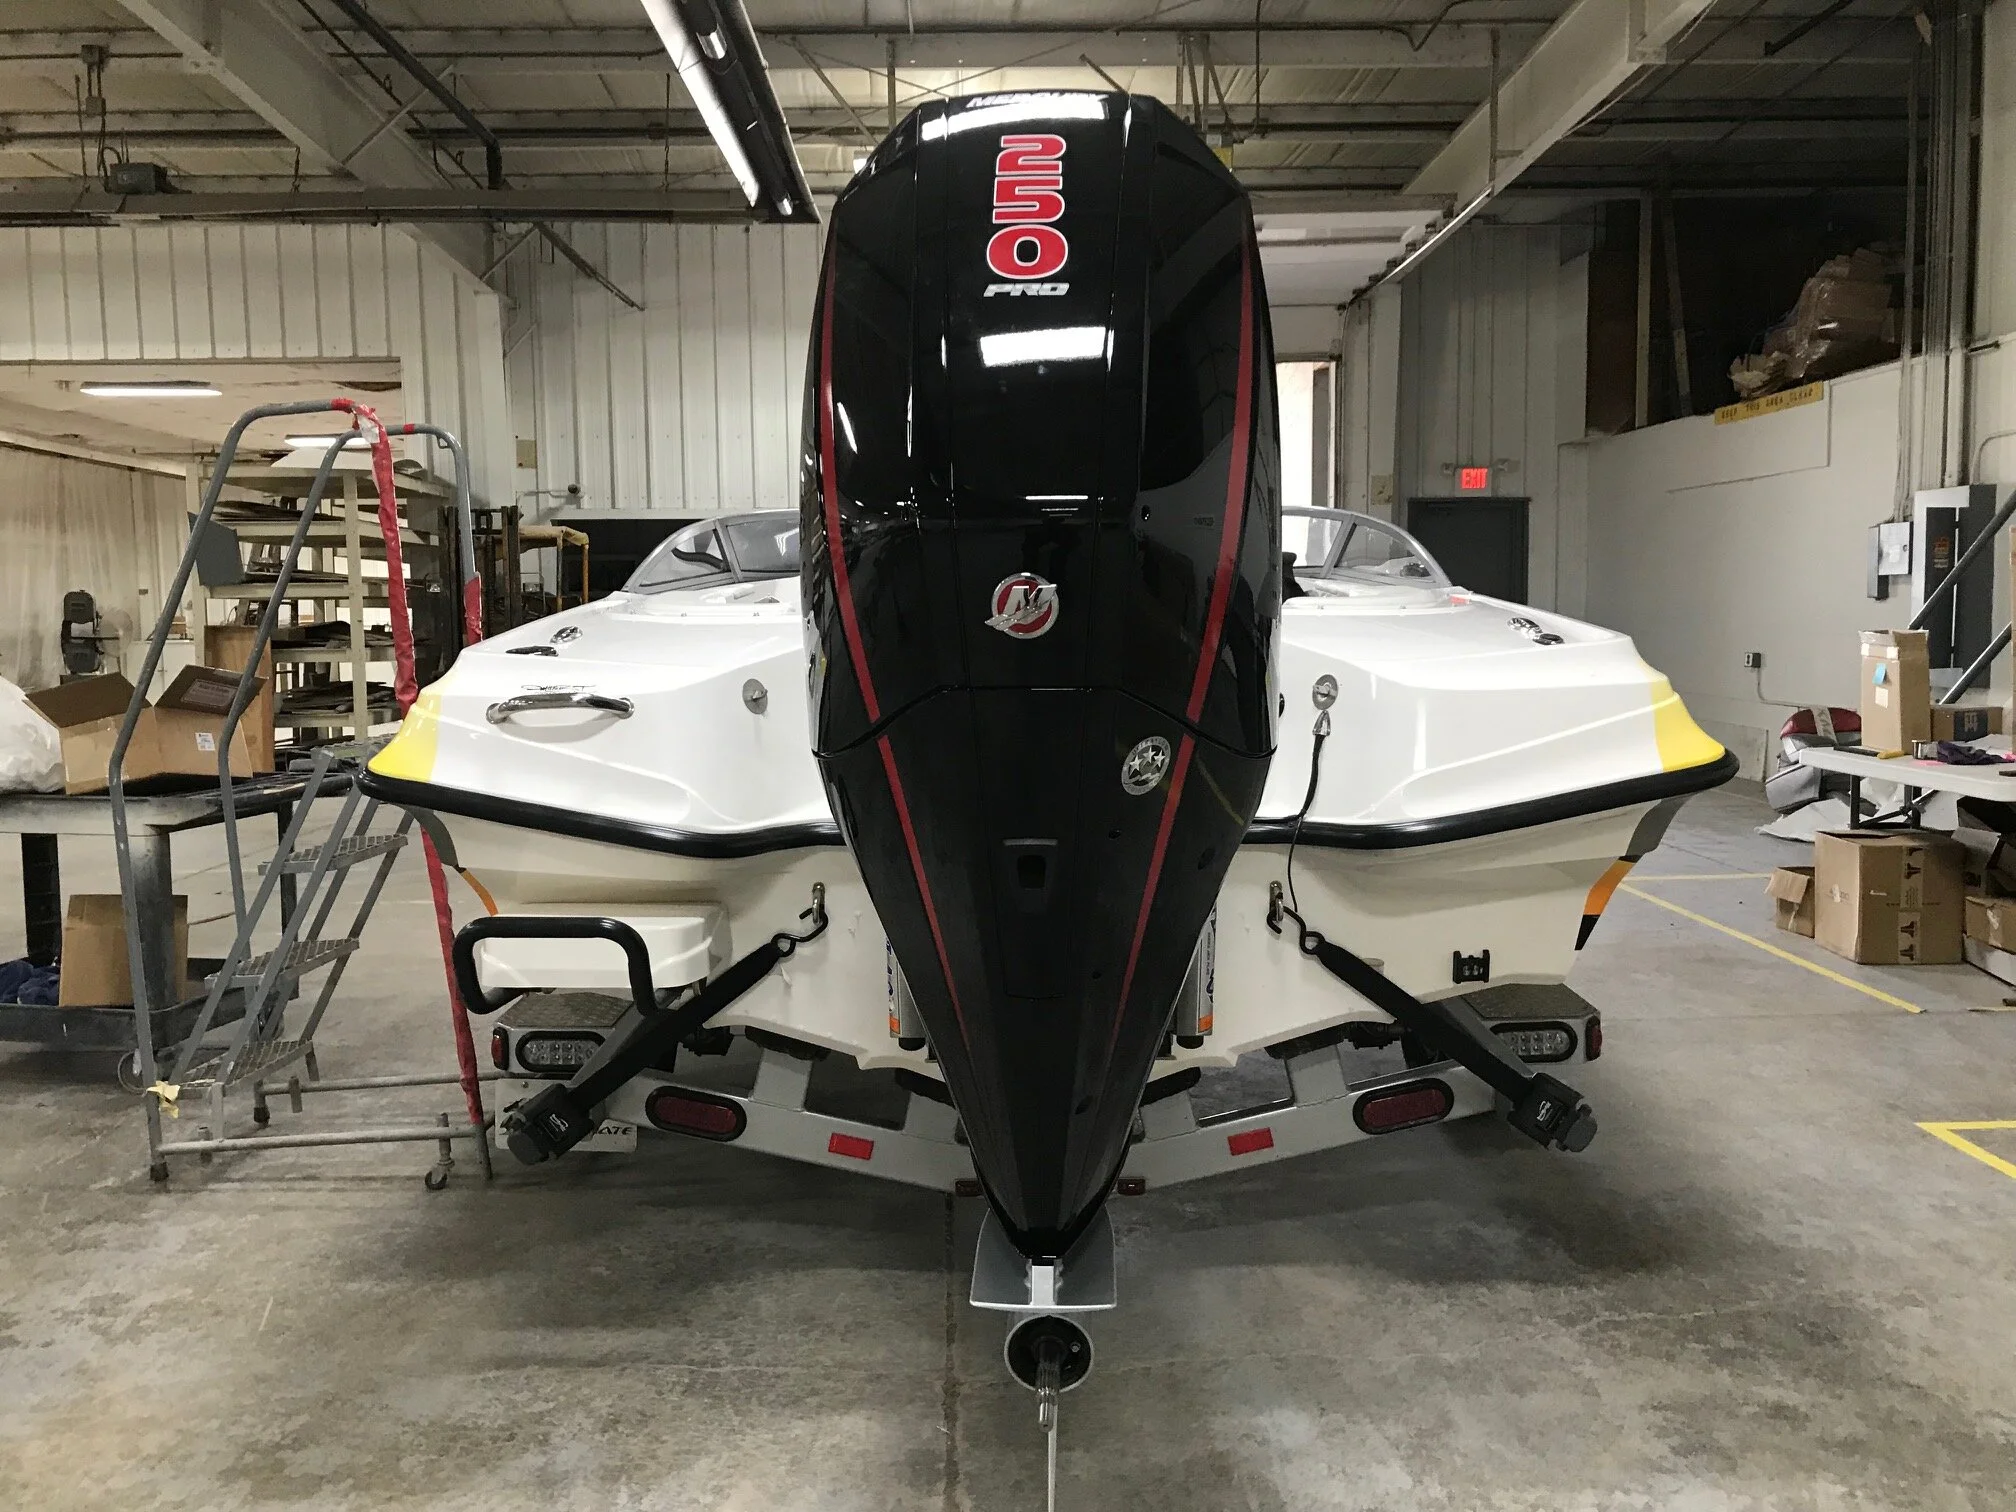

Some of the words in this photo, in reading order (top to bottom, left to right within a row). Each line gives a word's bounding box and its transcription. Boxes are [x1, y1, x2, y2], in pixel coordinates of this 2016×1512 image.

[986, 134, 1069, 280] 250
[983, 282, 1070, 298] PRO
[1746, 402, 1760, 412] THIS
[1766, 396, 1783, 407] AREA
[1461, 468, 1488, 489] EXIT
